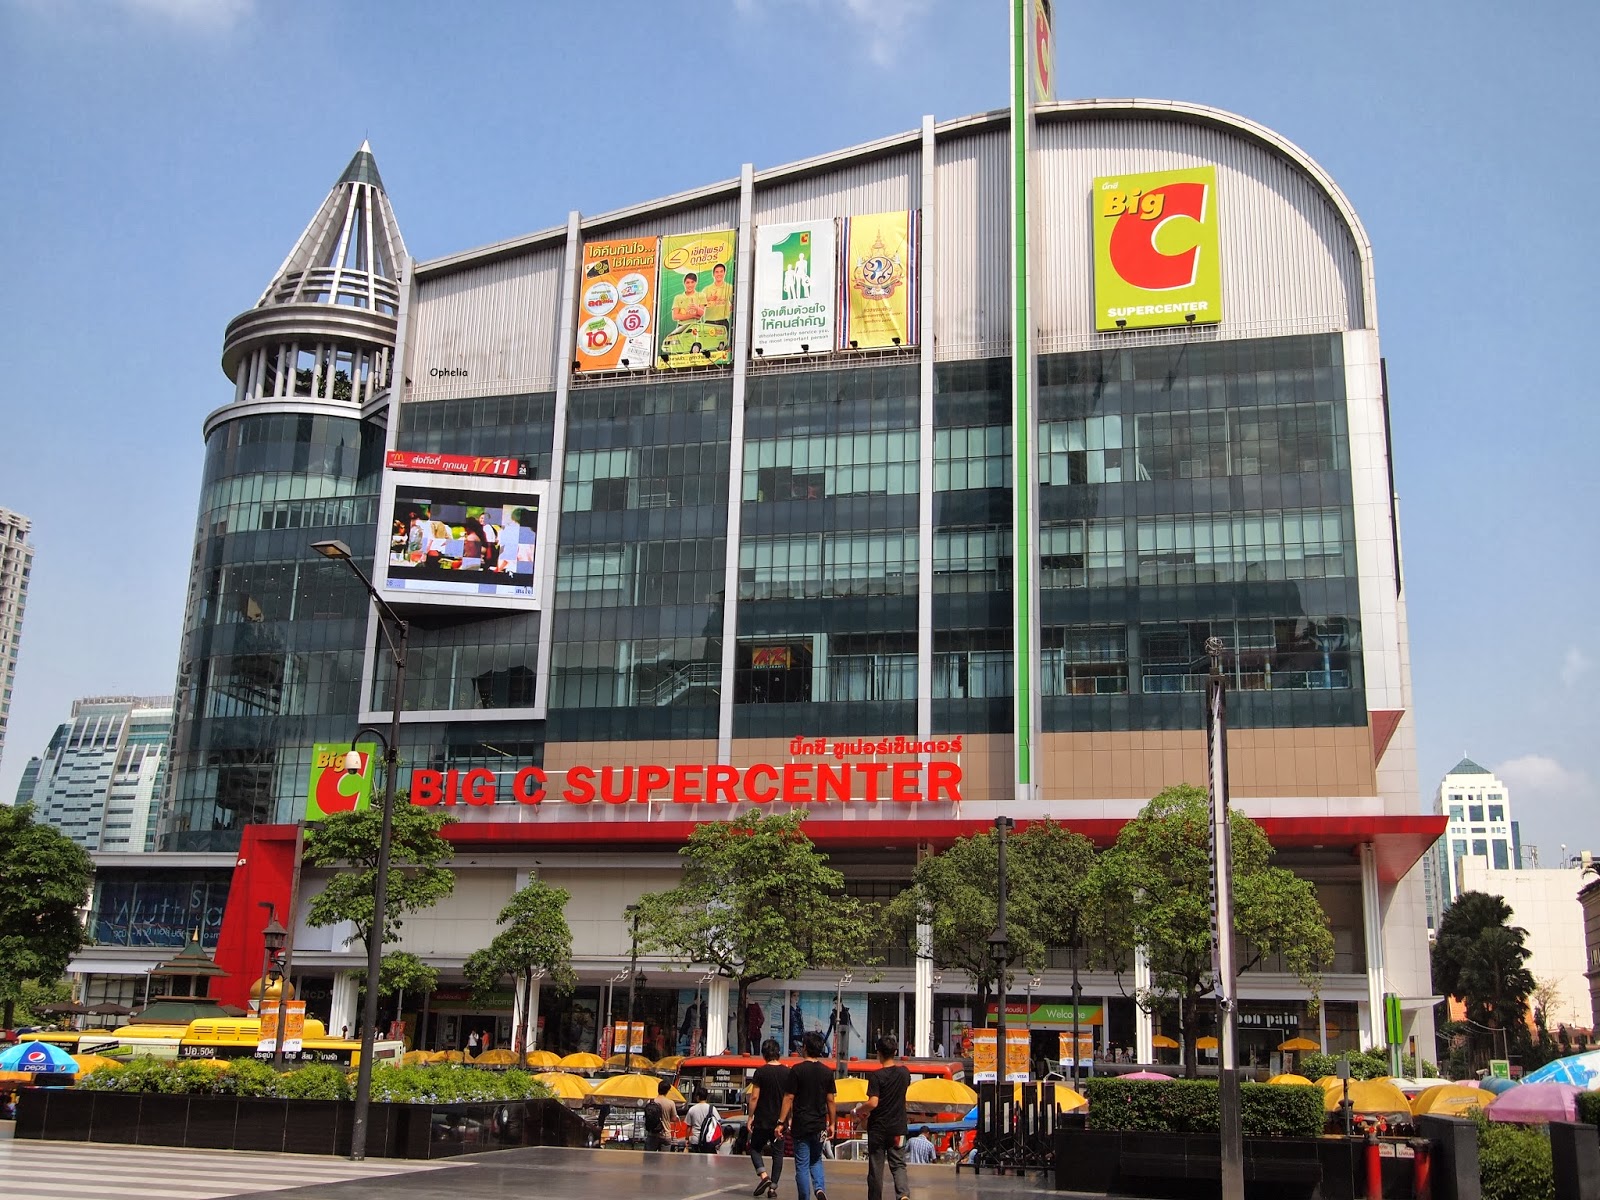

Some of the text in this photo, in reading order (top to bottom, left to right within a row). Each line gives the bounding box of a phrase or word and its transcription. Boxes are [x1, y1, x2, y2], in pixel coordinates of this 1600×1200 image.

[1103, 188, 1165, 221] Big
[1109, 182, 1209, 292] C
[761, 302, 826, 318] จัดเต็มด้วยใจ
[1107, 301, 1208, 317] SUPERCENTER
[628, 317, 637, 329] 5
[761, 315, 826, 331] ให้คนสำคัญ
[586, 330, 608, 348] 10
[472, 457, 510, 474] 1711
[789, 735, 963, 760] บิ๊กซี ซูเปอร์เซ็นเตอร์
[317, 752, 347, 772] Big
[410, 761, 963, 806] BIG C SUPERCENTER
[1266, 1012, 1298, 1028] pain
[24, 1064, 47, 1072] pepsi
